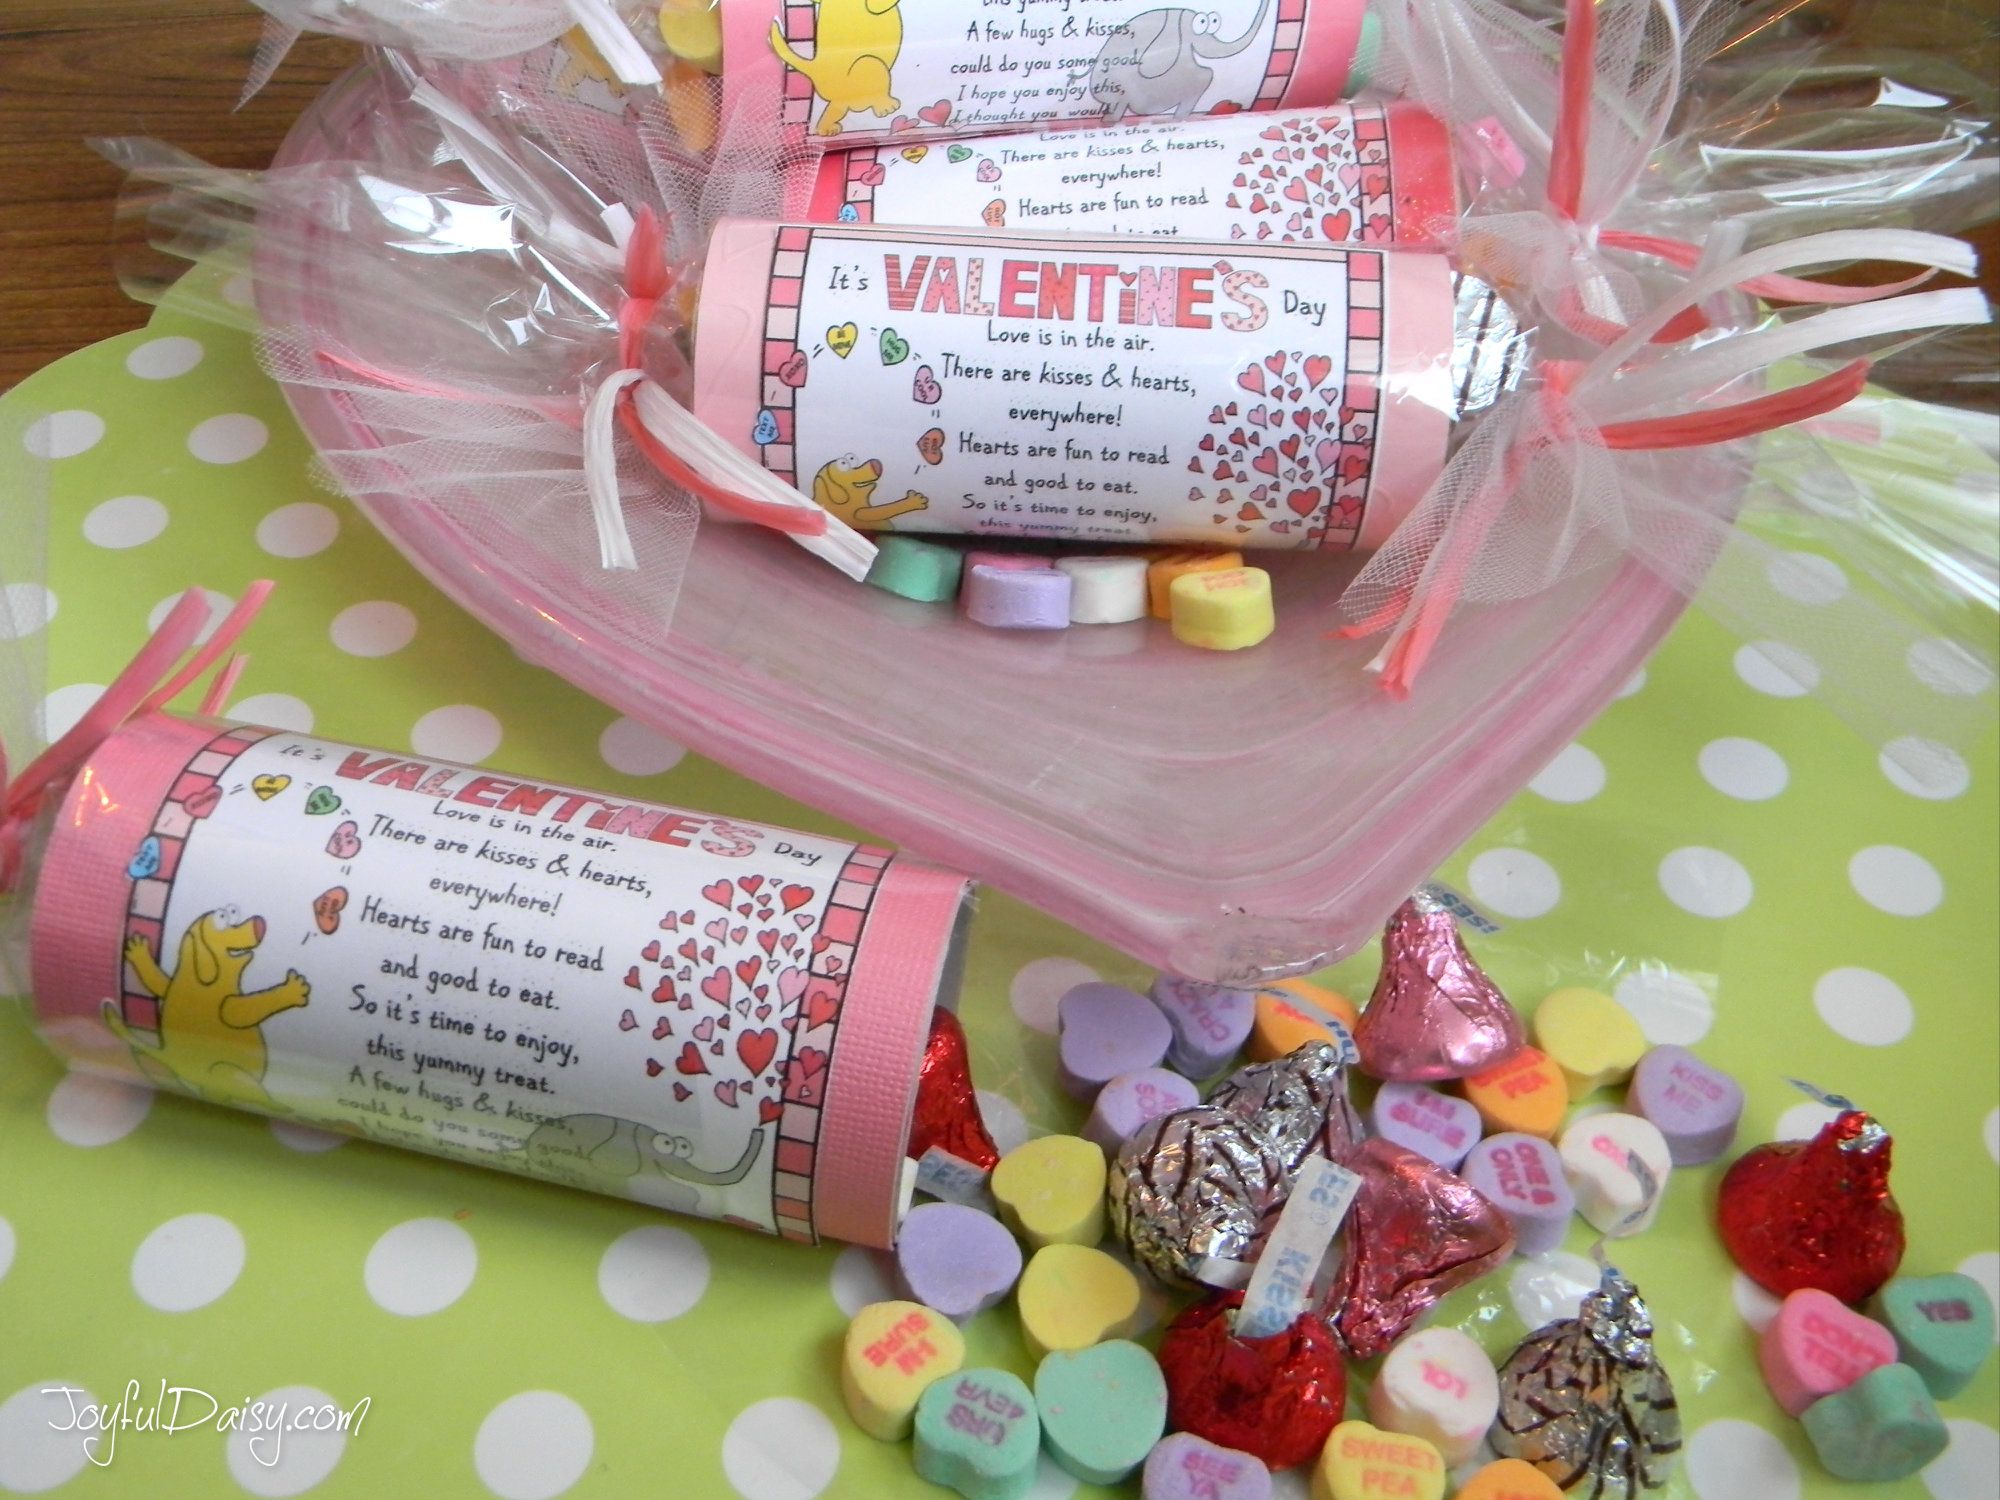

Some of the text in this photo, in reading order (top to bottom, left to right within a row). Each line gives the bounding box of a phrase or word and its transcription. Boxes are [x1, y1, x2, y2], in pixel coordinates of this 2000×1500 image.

[967, 16, 1136, 46] A few hugs & kisses,
[950, 54, 992, 74] could
[999, 54, 1018, 72] do
[1024, 58, 1051, 78] you
[1058, 56, 1097, 69] some
[957, 79, 1126, 105] I hope you enjoy this,
[967, 107, 1025, 123] thought
[1031, 110, 1058, 123] you
[1001, 139, 1225, 164] There are kisses & hearts,
[1040, 133, 1076, 141] Love
[1061, 162, 1162, 188] everywhere!
[1019, 198, 1073, 217] Hearts
[1081, 201, 1107, 212] are
[1113, 192, 1139, 212] fun
[1146, 195, 1163, 207] to
[1171, 187, 1209, 205] read
[829, 265, 869, 291] It's
[1284, 289, 1327, 326] Day
[987, 319, 1155, 352] Love is in the air.
[941, 352, 1197, 397] There are kisses & hearts,
[1009, 401, 1122, 432] everywhere!
[959, 431, 1170, 464] Hearts are fun to read
[984, 469, 1138, 495] and good to eat.
[962, 493, 1157, 523] So it's time to enjoy,
[980, 518, 1012, 528] this
[1019, 521, 1079, 534] yummy
[433, 799, 617, 852] Love is in the air.
[368, 813, 426, 845] There
[434, 836, 469, 854] are
[475, 840, 538, 870] kisses
[545, 853, 570, 877] &
[579, 860, 652, 899] hearts,
[773, 841, 823, 867] Day
[429, 875, 563, 917] everywhere!
[360, 895, 431, 935] Hearts
[439, 924, 474, 943] are
[483, 922, 515, 953] fun
[524, 939, 547, 959] to
[555, 946, 604, 972] read
[380, 954, 560, 1011] and good to eat.
[349, 984, 579, 1067] So it's time to enjoy,
[366, 1034, 555, 1095] this yummy treat.
[1670, 1061, 1723, 1100] KISS
[350, 1065, 574, 1136] A few hugs & kisses,
[433, 1118, 469, 1132] you
[1341, 1436, 1437, 1472] SWEET
[1360, 1469, 1418, 1495] PEA
